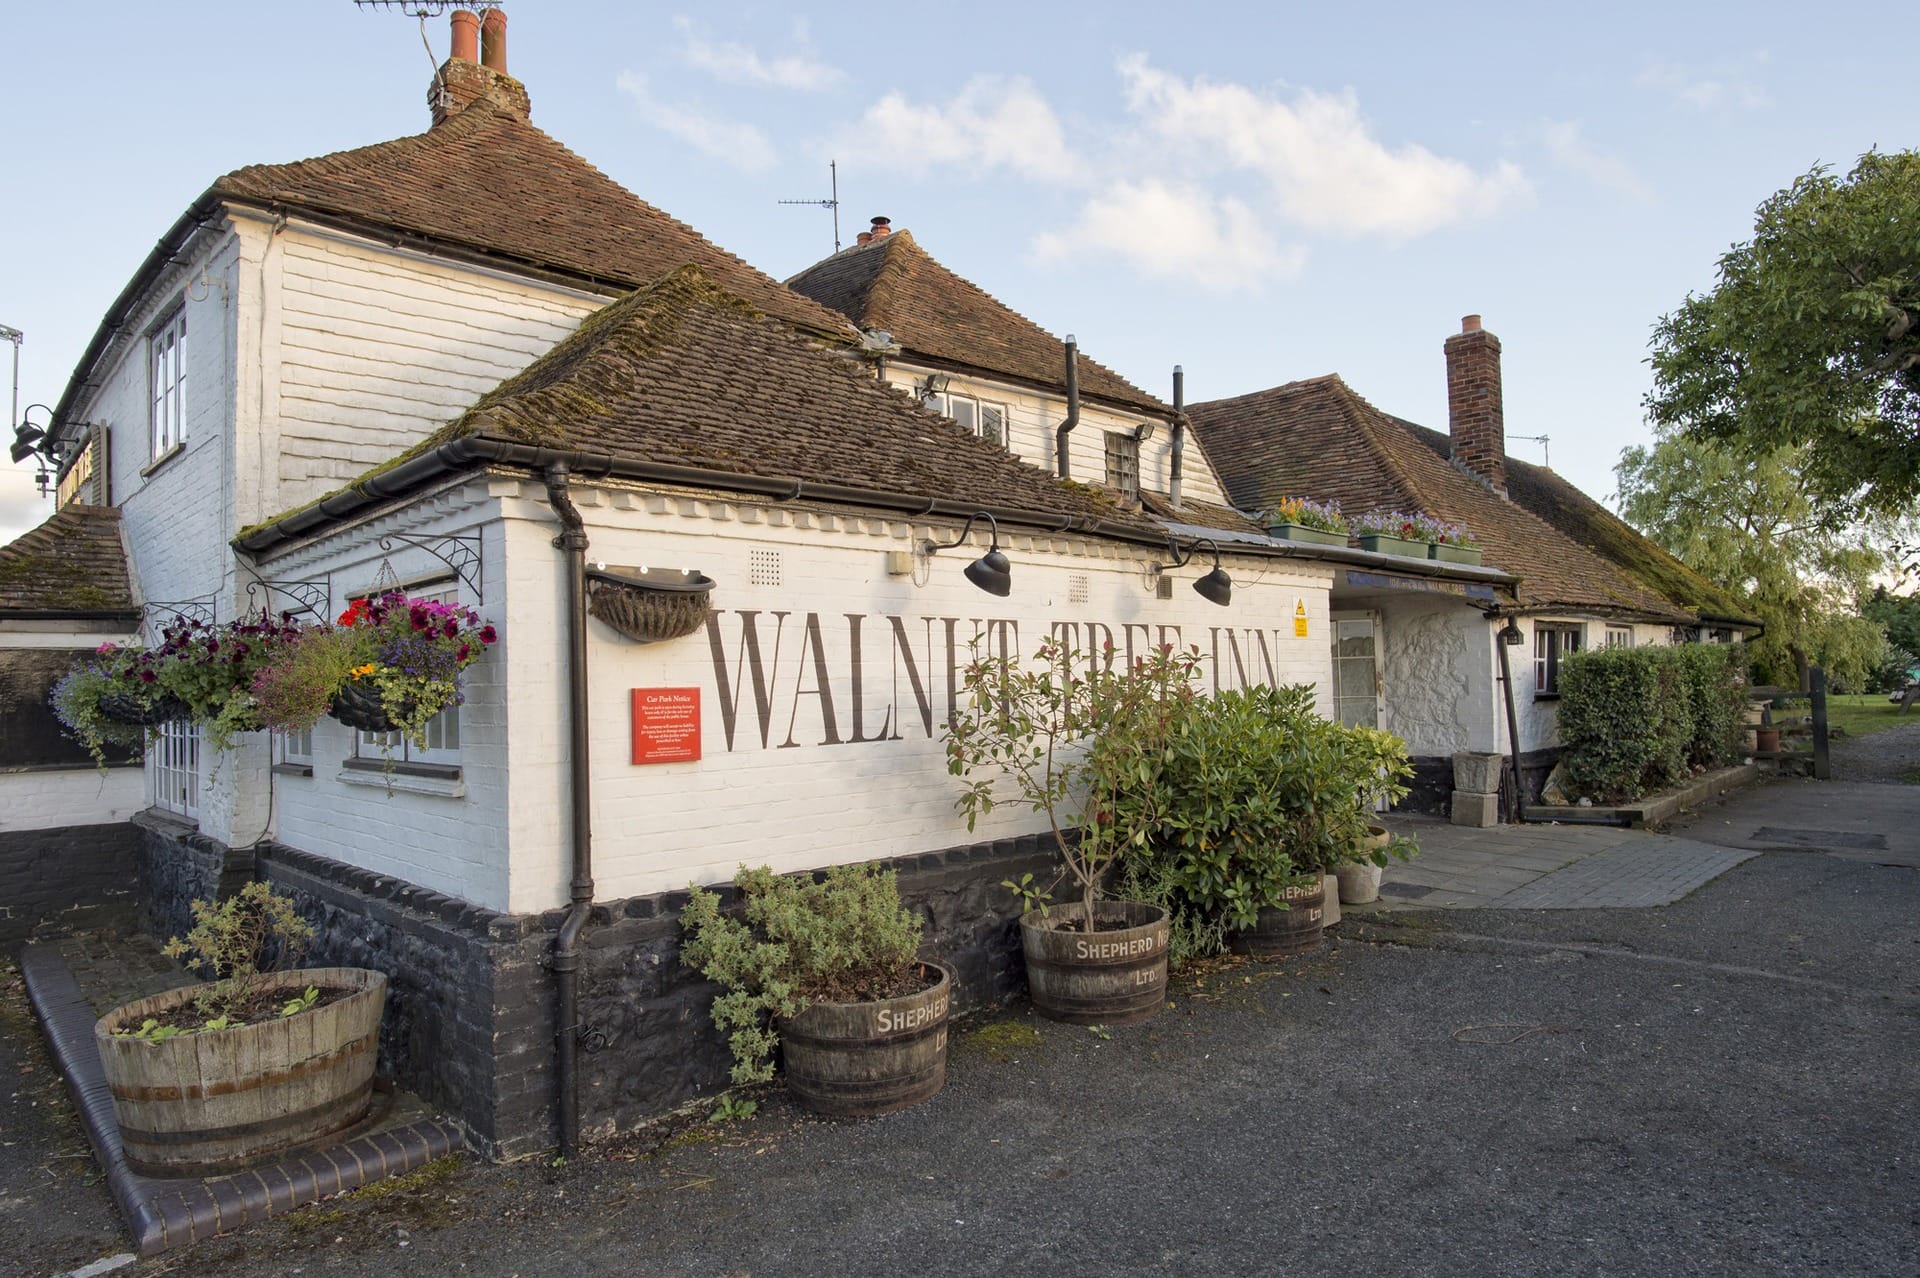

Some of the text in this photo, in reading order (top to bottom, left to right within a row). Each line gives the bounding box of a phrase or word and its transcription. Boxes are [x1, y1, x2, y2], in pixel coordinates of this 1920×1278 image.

[703, 609, 1019, 752] WALNUT
[646, 695, 691, 703] Car Park Notice
[1277, 881, 1322, 900] HEPHERD
[1076, 937, 1153, 959] SHEPHERD
